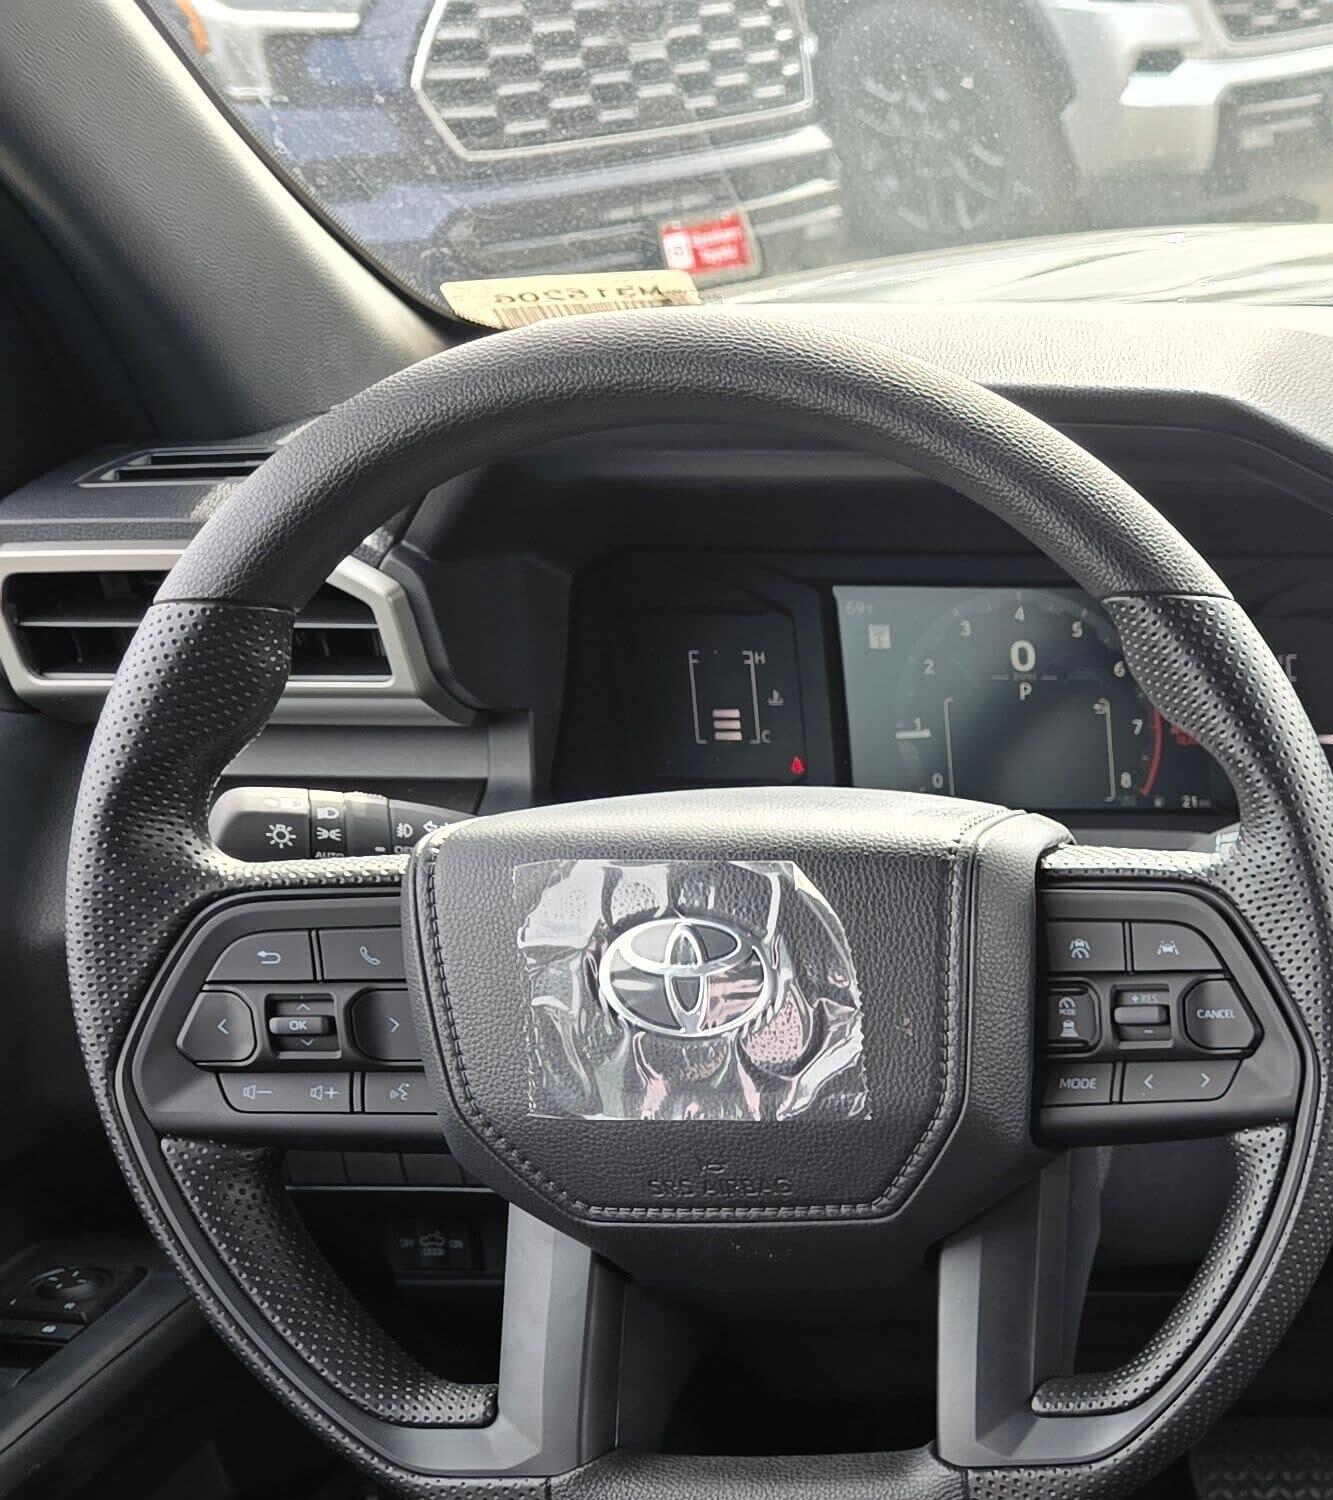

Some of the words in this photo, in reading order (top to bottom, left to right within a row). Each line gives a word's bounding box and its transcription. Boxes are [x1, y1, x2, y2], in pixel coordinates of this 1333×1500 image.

[1014, 606, 1025, 621] 4
[960, 621, 972, 637] 3
[1072, 622, 1083, 638] 5
[755, 651, 766, 664] H
[1010, 639, 1037, 672] 0
[923, 659, 935, 675] 2
[1114, 661, 1126, 678] 6
[1019, 683, 1032, 700] P
[1132, 720, 1143, 735] 7
[932, 773, 943, 788] 0
[1197, 1009, 1235, 1019] CANCEL
[289, 1020, 308, 1031] OK
[1059, 1077, 1097, 1090] MODE
